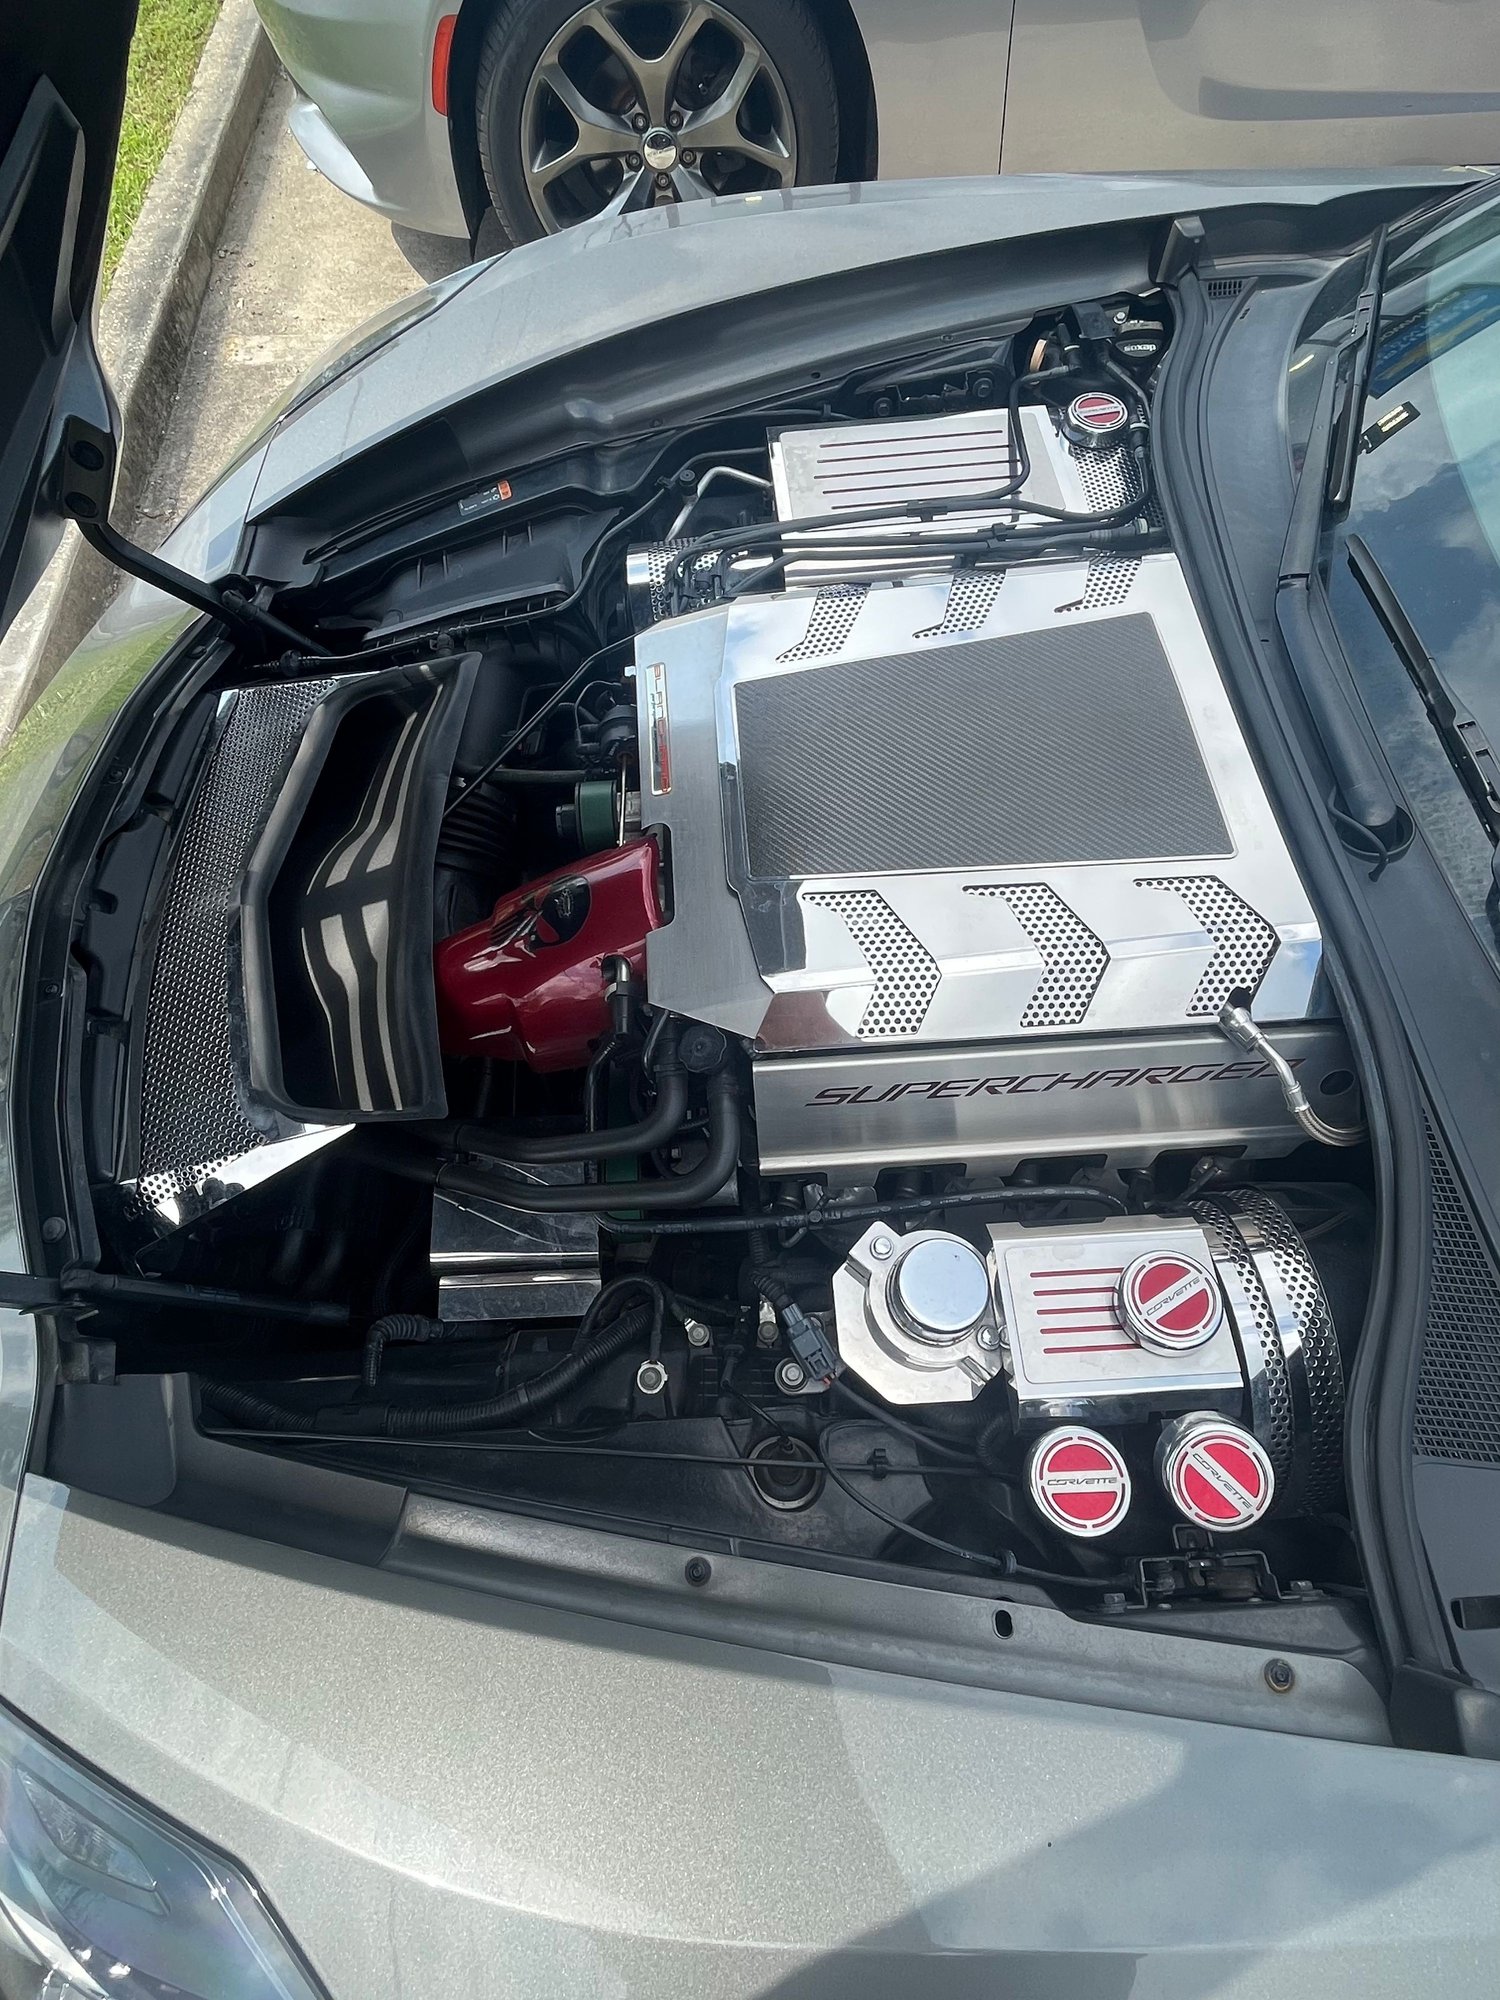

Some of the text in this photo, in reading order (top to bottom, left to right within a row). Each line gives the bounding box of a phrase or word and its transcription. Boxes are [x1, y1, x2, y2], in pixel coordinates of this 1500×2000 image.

[1123, 344, 1157, 352] dexos
[804, 1058, 1306, 1107] SUPERCHARGED
[1146, 1276, 1200, 1316] CORVETTE
[1047, 1477, 1117, 1486] CORVETTE
[1192, 1453, 1253, 1510] CORVETTE
